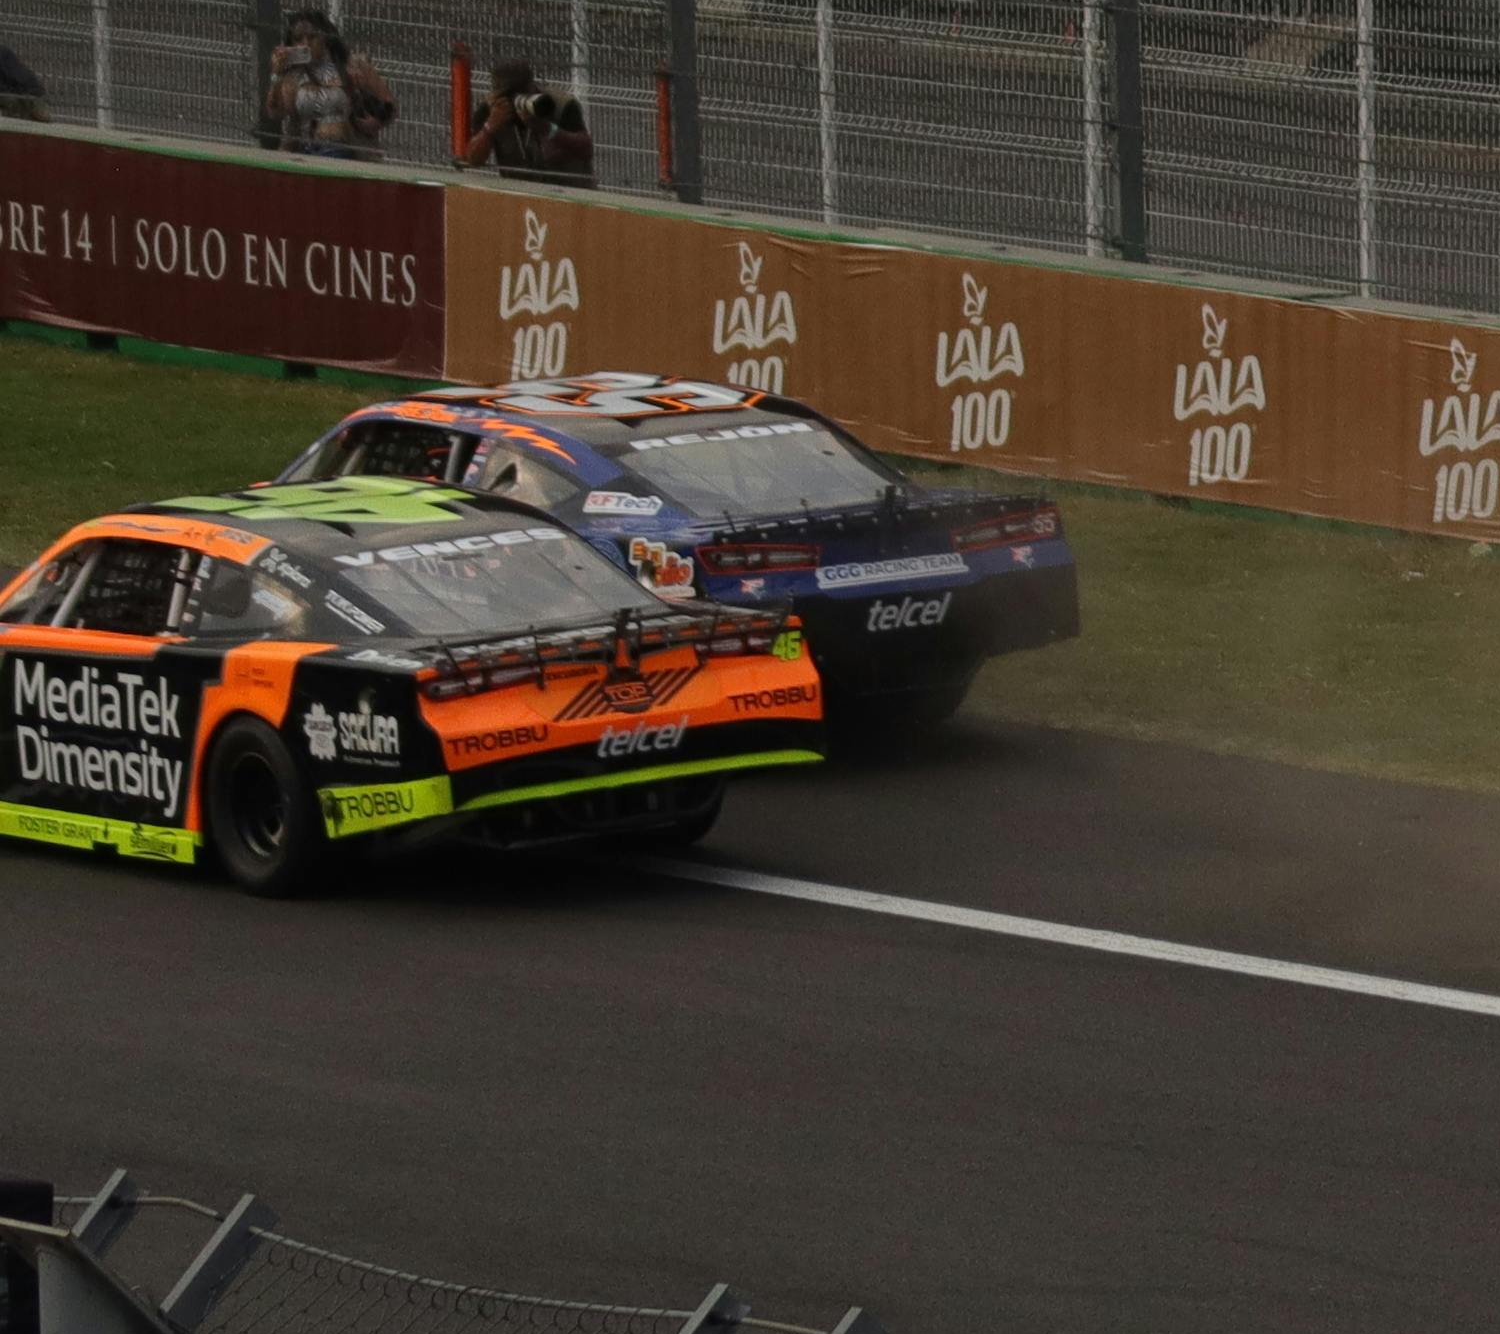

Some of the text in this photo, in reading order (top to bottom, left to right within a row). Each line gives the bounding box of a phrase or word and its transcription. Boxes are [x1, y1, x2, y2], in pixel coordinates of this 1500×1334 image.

[60, 209, 94, 263] 14
[135, 218, 228, 281] SOLO
[242, 233, 289, 289] EN
[304, 242, 418, 307] CINES
[499, 256, 581, 322] LALA
[713, 288, 798, 357] LALA
[935, 321, 1025, 389] LALA
[950, 388, 1013, 452] 100
[1173, 354, 1267, 422] LALA
[1188, 422, 1253, 486] 100
[1432, 458, 1500, 524] 100
[867, 590, 952, 633] telcel
[13, 657, 182, 739] MediaTek
[729, 683, 818, 714] TROBBU
[448, 724, 550, 757] TROBBU
[597, 715, 691, 758] telcel
[16, 724, 184, 820] Dimensity
